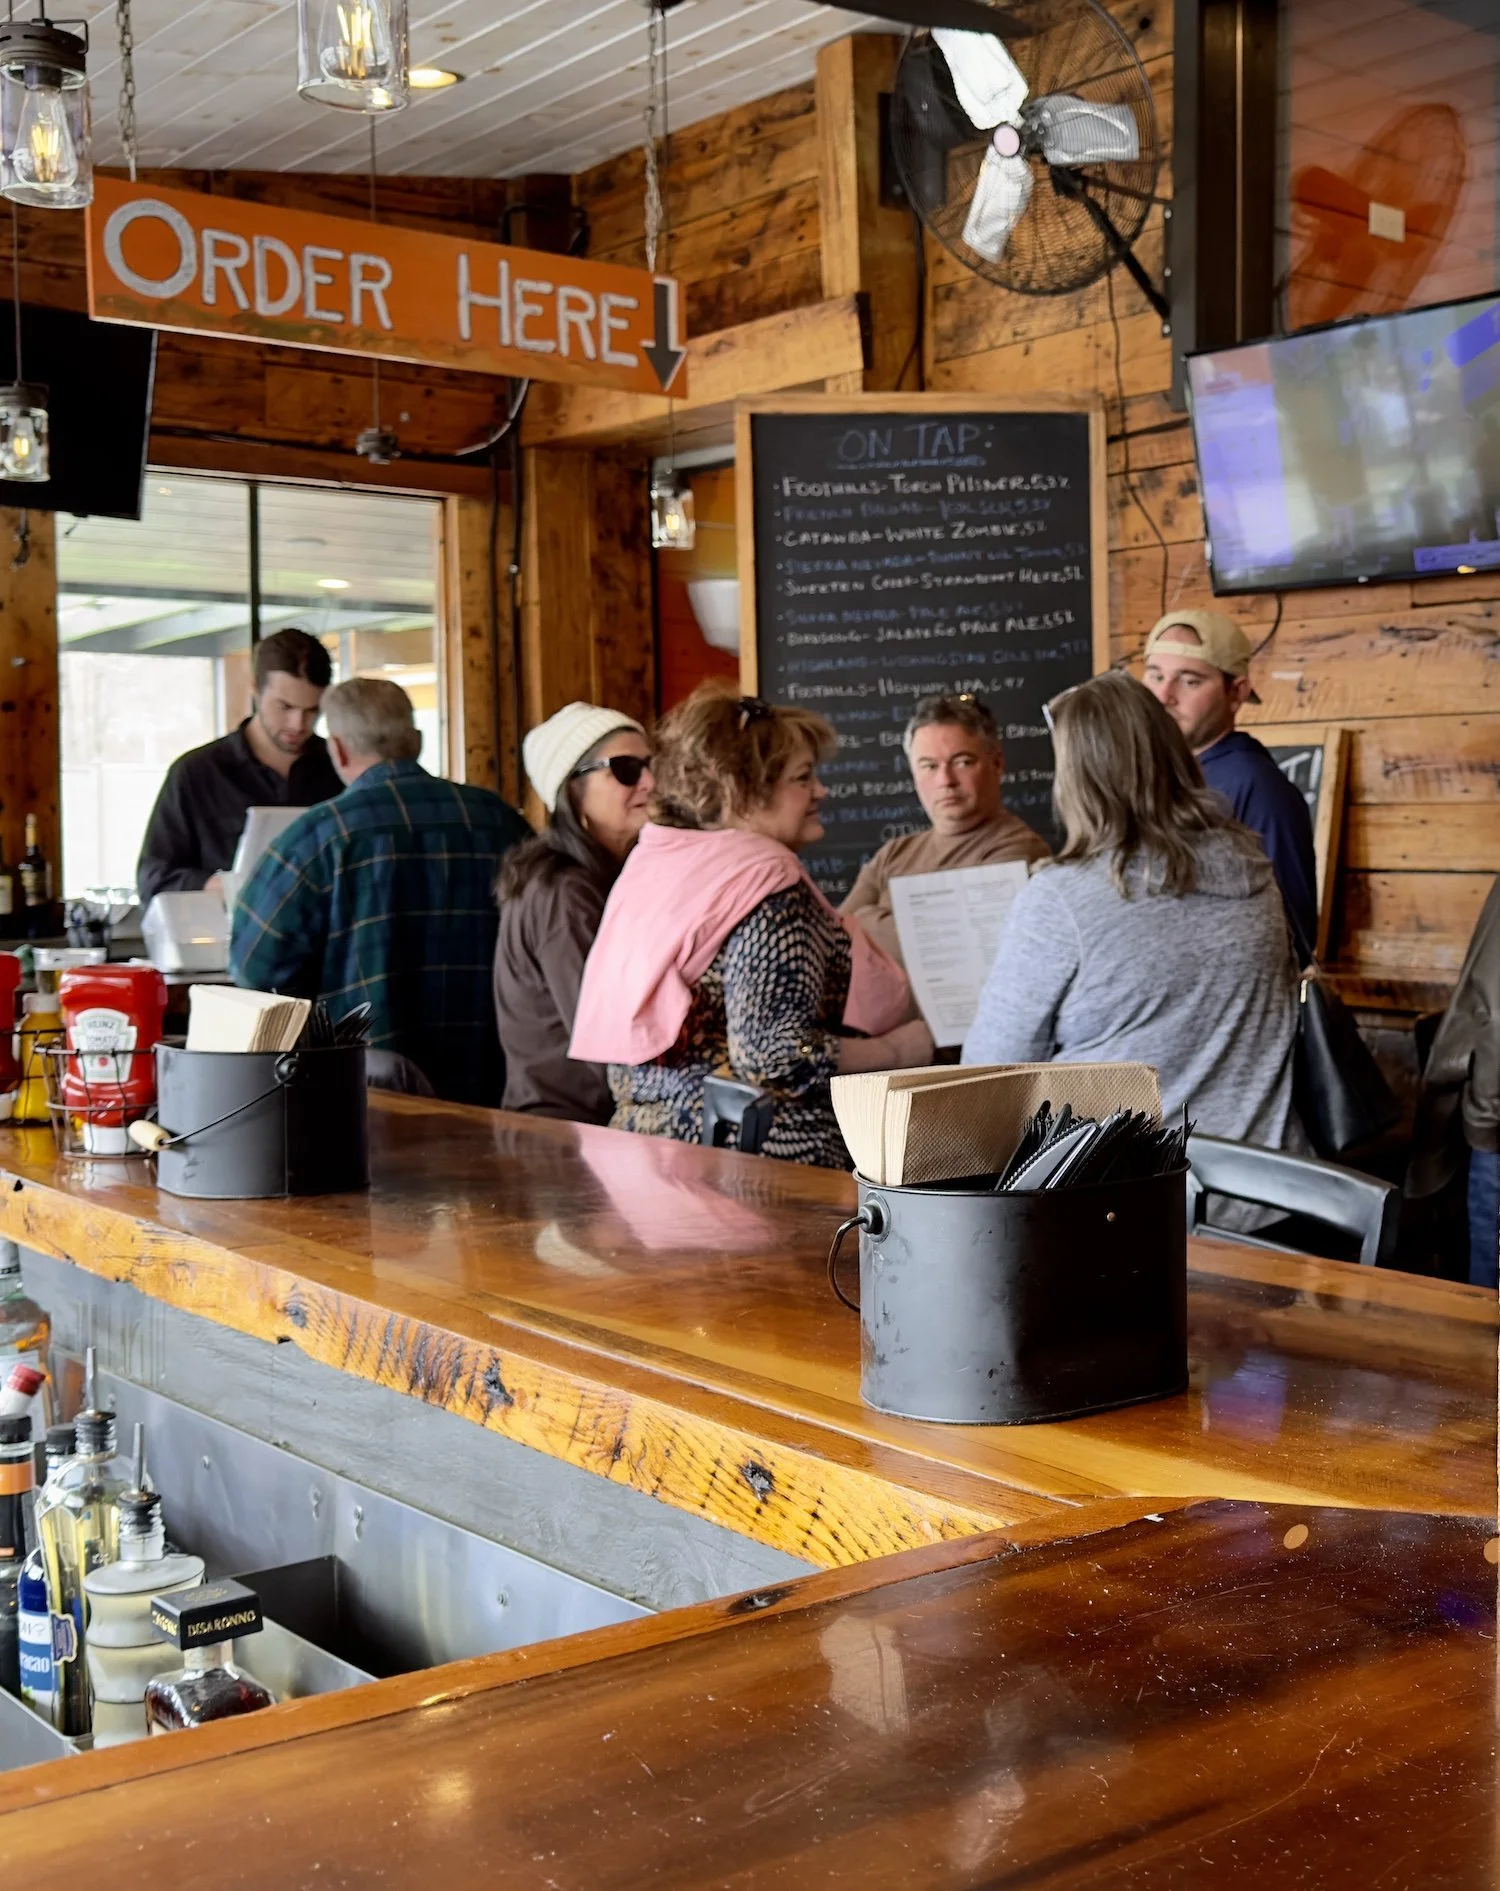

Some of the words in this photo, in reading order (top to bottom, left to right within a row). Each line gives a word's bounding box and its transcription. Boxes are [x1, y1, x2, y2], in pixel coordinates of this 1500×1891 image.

[103, 198, 392, 330] ORDER
[457, 252, 638, 367] HERE
[837, 428, 893, 463] ON
